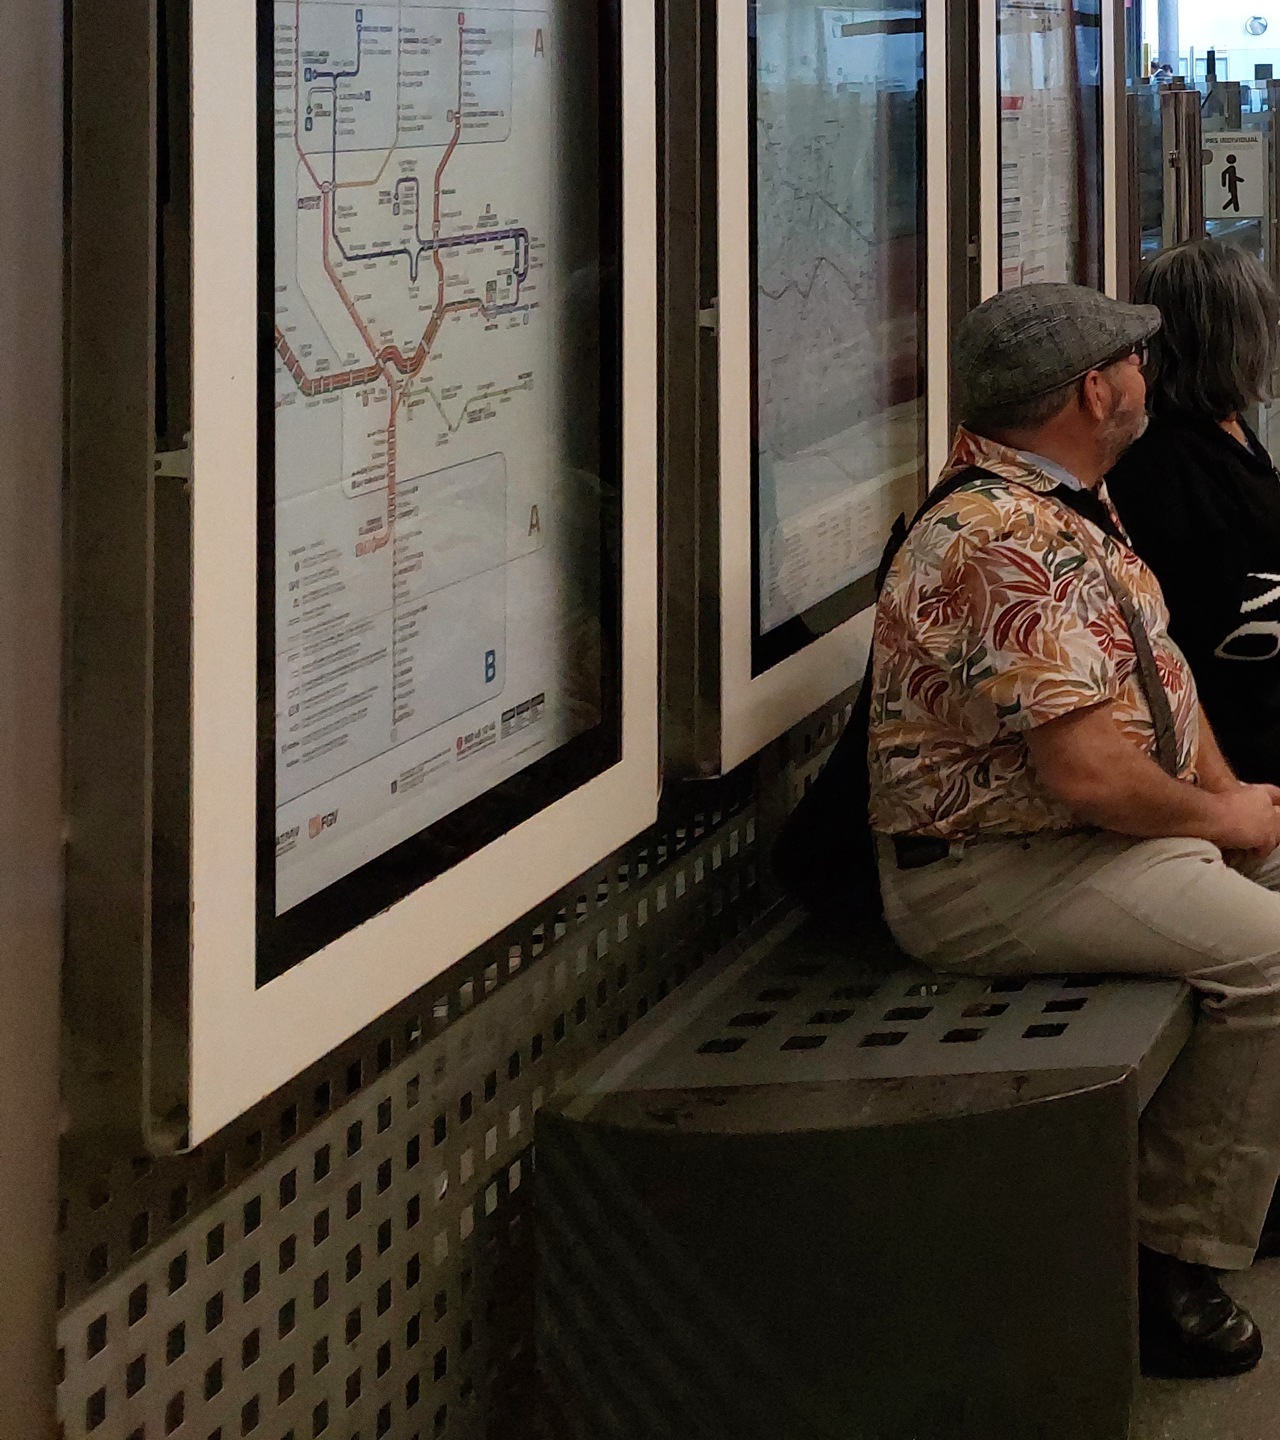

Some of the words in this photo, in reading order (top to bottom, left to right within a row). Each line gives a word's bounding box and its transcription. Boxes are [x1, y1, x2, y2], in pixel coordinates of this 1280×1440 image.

[534, 28, 544, 58] A
[528, 504, 541, 537] A
[485, 649, 496, 684] B
